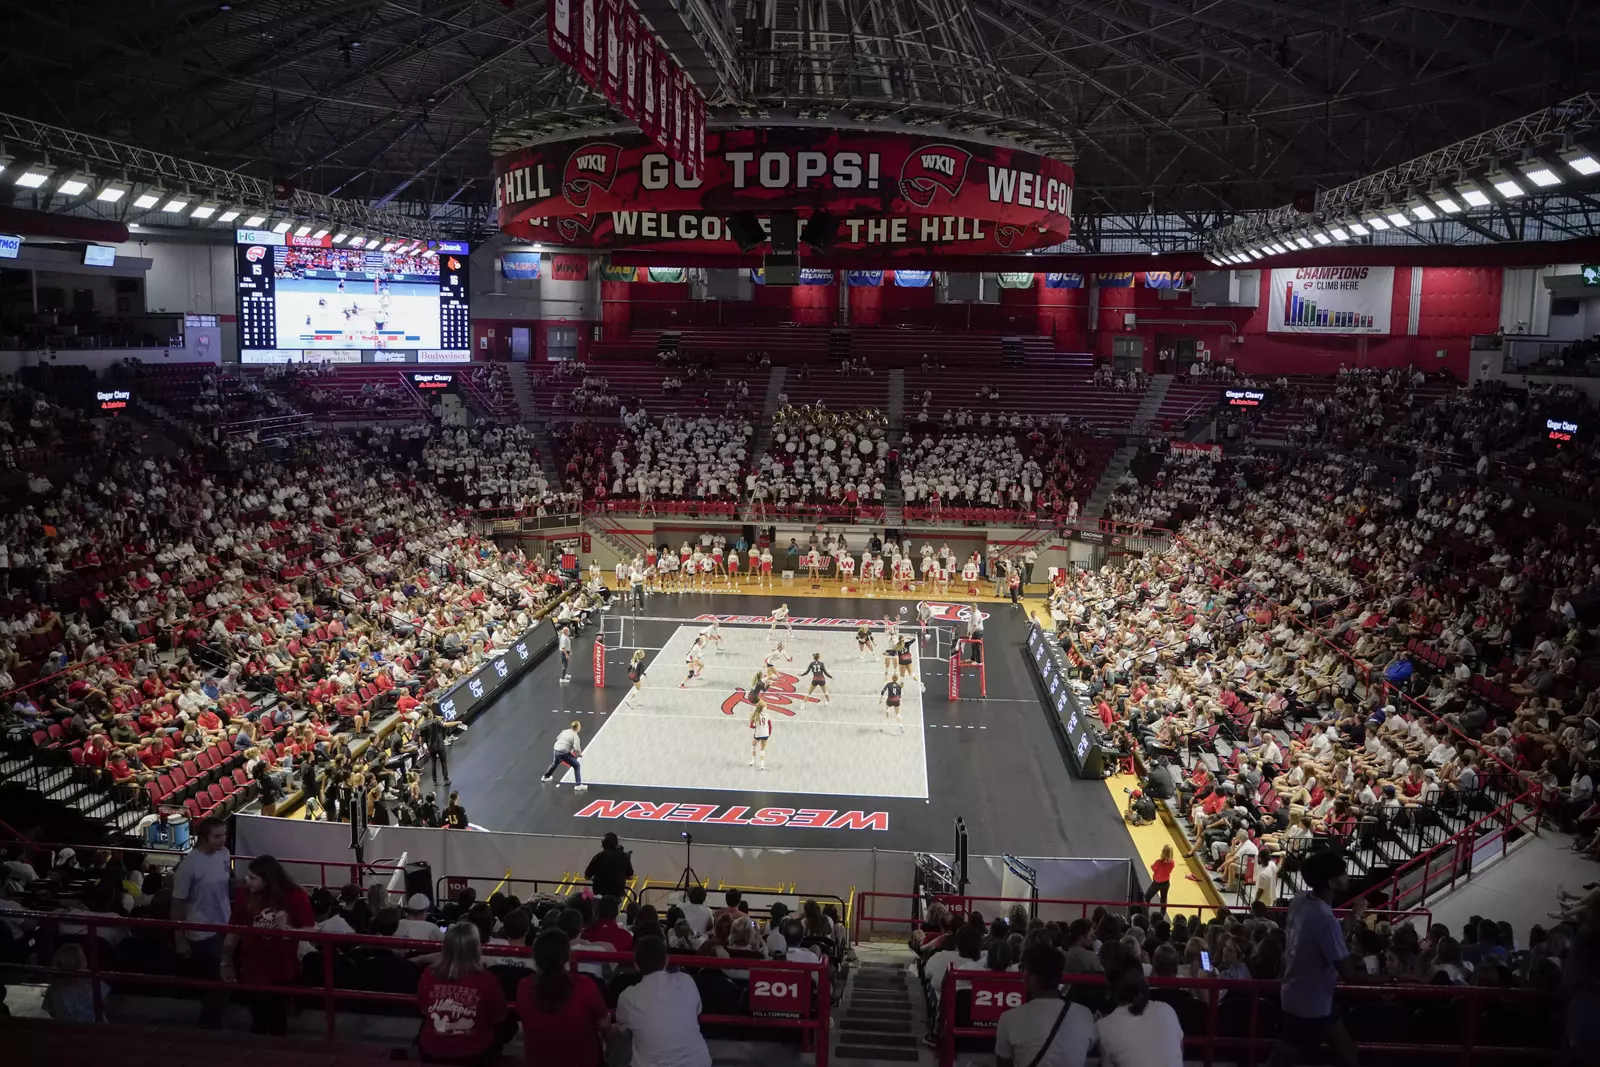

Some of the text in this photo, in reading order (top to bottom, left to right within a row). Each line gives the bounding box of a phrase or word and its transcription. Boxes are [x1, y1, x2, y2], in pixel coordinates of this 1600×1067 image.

[576, 154, 606, 172] WKU
[726, 152, 879, 189] TOPS!
[921, 154, 956, 176] WKU
[504, 164, 550, 204] HILL
[612, 212, 771, 242] WELCOE
[846, 218, 907, 242] THE
[920, 216, 985, 242] HILL
[1048, 272, 1080, 280] RICE
[1296, 267, 1369, 280] CHAMPIONS
[1317, 281, 1359, 290] CLIMB HERE
[421, 352, 466, 360] Budweiser
[799, 555, 831, 567] WU
[939, 571, 946, 580] L
[448, 815, 458, 824] 13
[574, 799, 889, 831] WESTERN
[754, 981, 797, 998] 201
[975, 990, 1022, 1007] 216
[428, 999, 476, 1018] Hilltoppers
